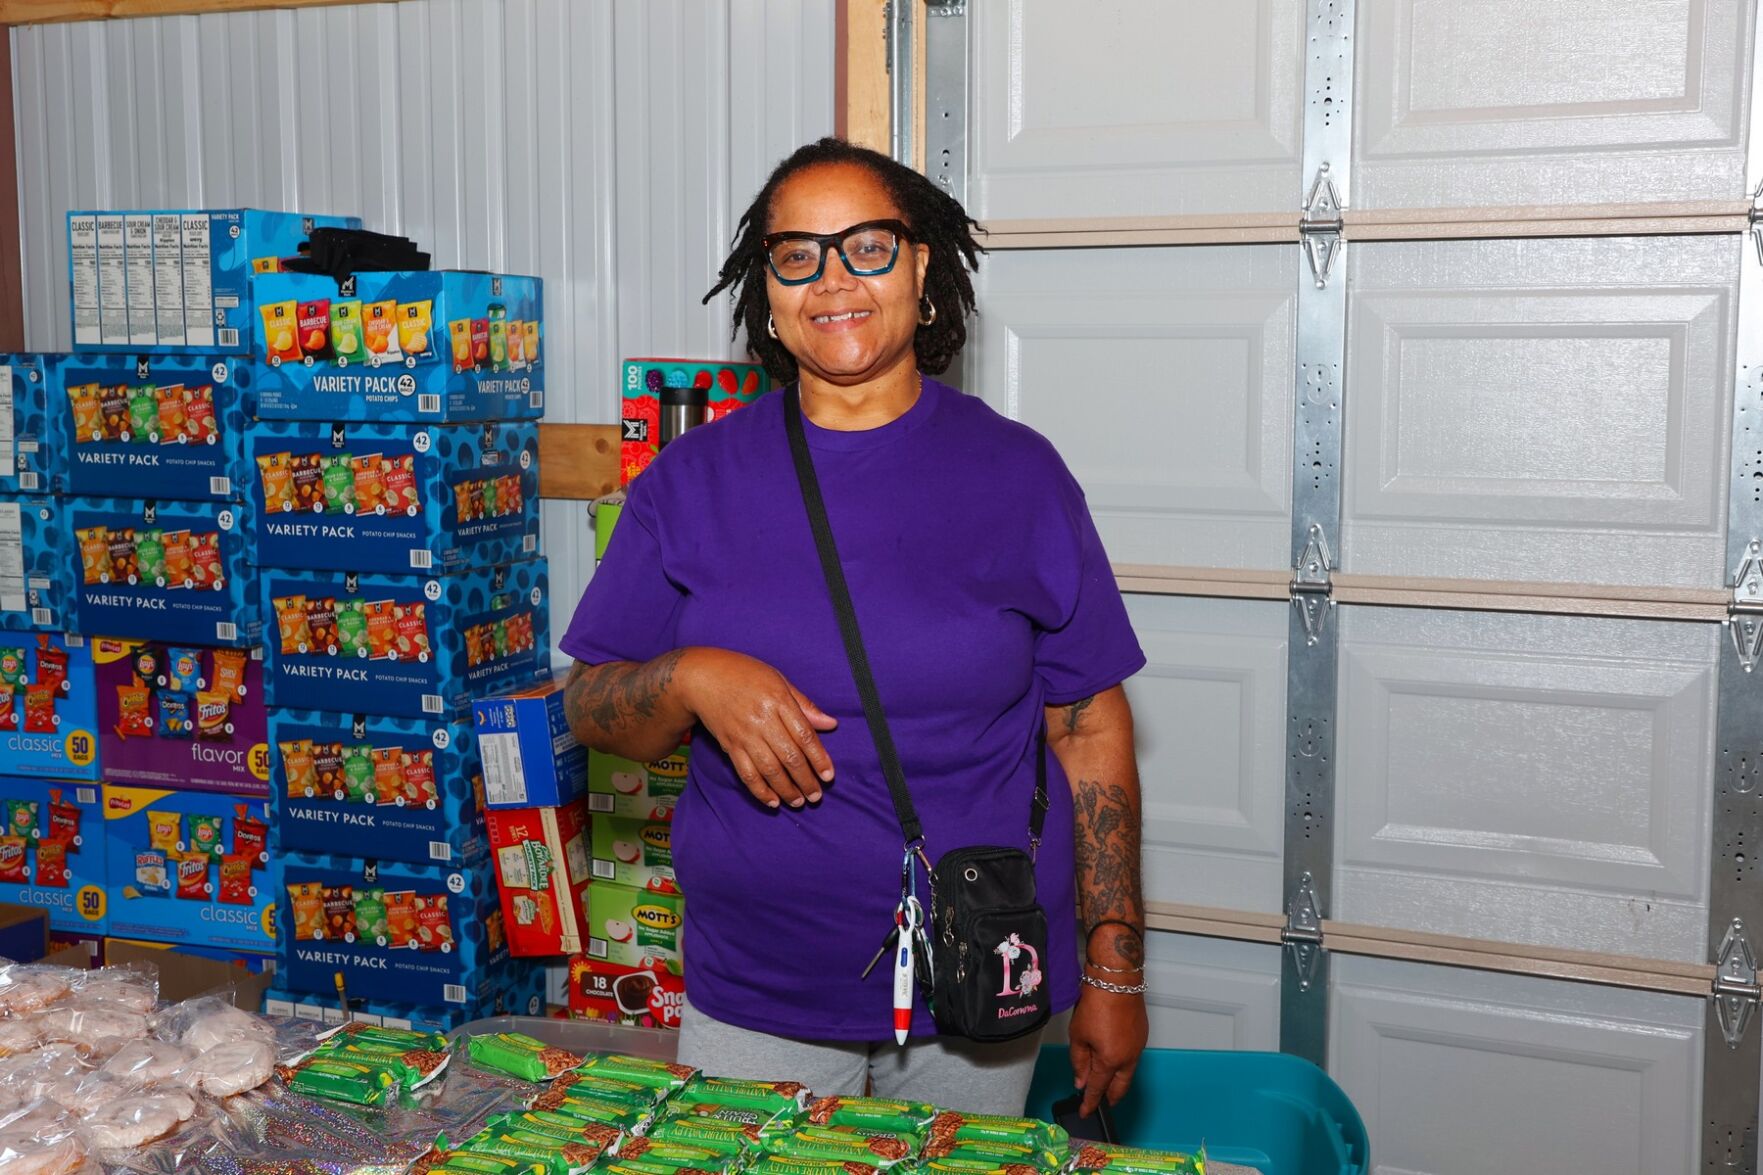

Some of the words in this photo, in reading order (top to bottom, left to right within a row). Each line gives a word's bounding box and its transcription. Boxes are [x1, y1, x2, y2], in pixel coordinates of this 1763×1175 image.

[72, 222, 94, 231] CLASSIC
[99, 221, 122, 230] BARBECUE
[183, 221, 208, 230] CLASSIC
[269, 319, 291, 327] CLASSIC
[300, 316, 327, 328] BARBECUE
[403, 320, 425, 328] CLASSIC
[215, 367, 225, 376] 42
[400, 377, 413, 387] 42
[628, 366, 637, 390] 100
[314, 376, 361, 392] VARIETY
[365, 377, 396, 392] PACK
[478, 381, 503, 393] VARIETY
[505, 380, 520, 392] PACK
[188, 403, 210, 411] CLASSIC
[415, 436, 427, 445] 42
[78, 453, 125, 465] VARIETY
[129, 454, 159, 466] PACK
[522, 454, 528, 462] 42
[266, 471, 288, 479] CLASSIC
[292, 469, 321, 477] BARBECUE
[387, 473, 411, 482] CLASSIC
[220, 514, 231, 524] 42
[267, 524, 318, 536] VARIETY
[322, 526, 355, 538] PACK
[458, 526, 481, 536] VARIETY
[483, 524, 497, 533] PACK
[109, 542, 134, 550] BARBECUE
[194, 549, 217, 558] CLASSIC
[426, 584, 438, 593] 42
[86, 594, 133, 607] VARIETY
[136, 597, 167, 610] PACK
[281, 613, 303, 621] CLASSIC
[307, 612, 335, 620] BARBECUE
[399, 620, 423, 628] CLASSIC
[2, 660, 16, 668] Lay's
[40, 661, 63, 670] Doritos
[139, 659, 155, 670] Lay's
[178, 661, 193, 672] Lay's
[283, 664, 332, 678] VARIETY
[337, 668, 368, 681] PACK
[468, 667, 492, 680] VARIETY
[494, 663, 508, 673] PACK
[161, 701, 185, 711] Doritos
[200, 703, 226, 718] Fritos
[435, 732, 447, 742] 42
[8, 736, 62, 752] classic
[72, 737, 88, 754] 50
[192, 743, 244, 764] flavor
[53, 816, 74, 825] Doritos
[289, 808, 339, 823] VARIETY
[343, 812, 375, 827] PACK
[156, 825, 172, 834] Lay's
[382, 820, 402, 828] POTATO
[416, 823, 435, 831] SNACKS
[197, 828, 213, 838] Lay's
[515, 825, 528, 837] 12
[237, 831, 261, 842] Doritos
[0, 847, 22, 860] Fritos
[524, 843, 535, 870] VARIETY
[137, 855, 164, 865] RUFFLES
[531, 841, 549, 889] BOYARDEE
[180, 860, 205, 878] Fritos
[449, 877, 462, 887] 42
[20, 888, 72, 906] classic
[83, 892, 99, 909] 50
[323, 900, 352, 908] BARBECUE
[201, 906, 258, 924] classic
[420, 911, 446, 919] CLASSIC
[637, 910, 677, 924] MOTT'S
[644, 932, 669, 940] APPLESAUCE
[660, 928, 675, 936] Added
[297, 949, 350, 965] VARIETY
[354, 955, 387, 970] PACK
[416, 964, 429, 972] CHIP
[430, 966, 450, 974] SNACKS
[593, 976, 607, 989] 18
[586, 989, 613, 997] CHOCOLATE
[703, 1084, 733, 1093] VALLEY
[735, 1087, 767, 1097] NATURE
[719, 1110, 758, 1119] GRAIN
[672, 1127, 703, 1138] VALLEY
[705, 1131, 736, 1142] NATURE
[796, 1140, 829, 1153] VALLEY
[831, 1146, 864, 1157] NATURE
[767, 1162, 800, 1173] VALLEY
[801, 1166, 838, 1175] NATURE
